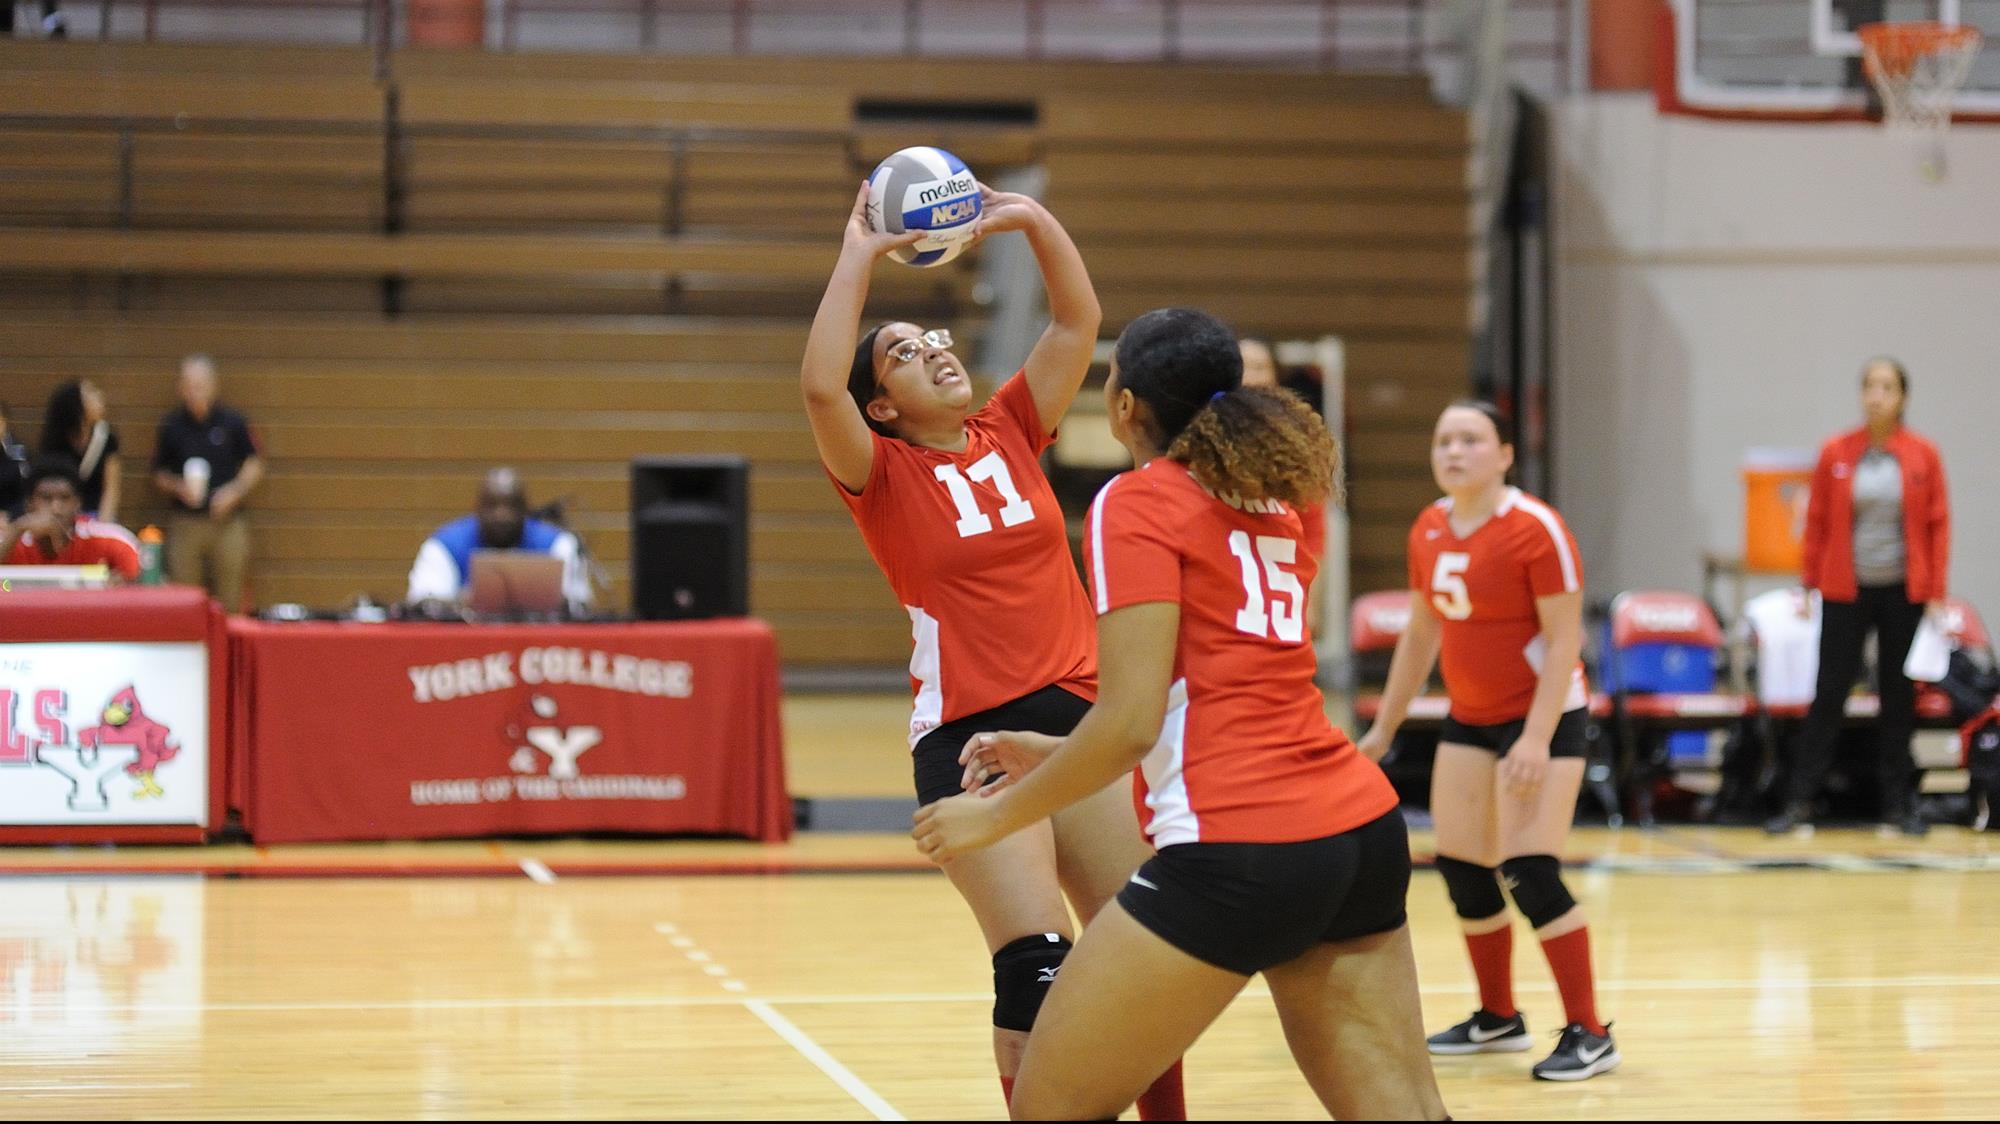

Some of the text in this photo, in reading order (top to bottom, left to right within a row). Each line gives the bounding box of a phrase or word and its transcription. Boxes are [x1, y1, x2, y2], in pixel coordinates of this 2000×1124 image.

[920, 180, 975, 204] molten
[931, 199, 977, 227] NCAA
[934, 451, 1035, 538] 17
[1229, 530, 1304, 642] 15
[1432, 551, 1473, 621] 5
[407, 646, 694, 703] YORK COLLEGE
[410, 779, 481, 806] HOME
[481, 776, 513, 803] OF
